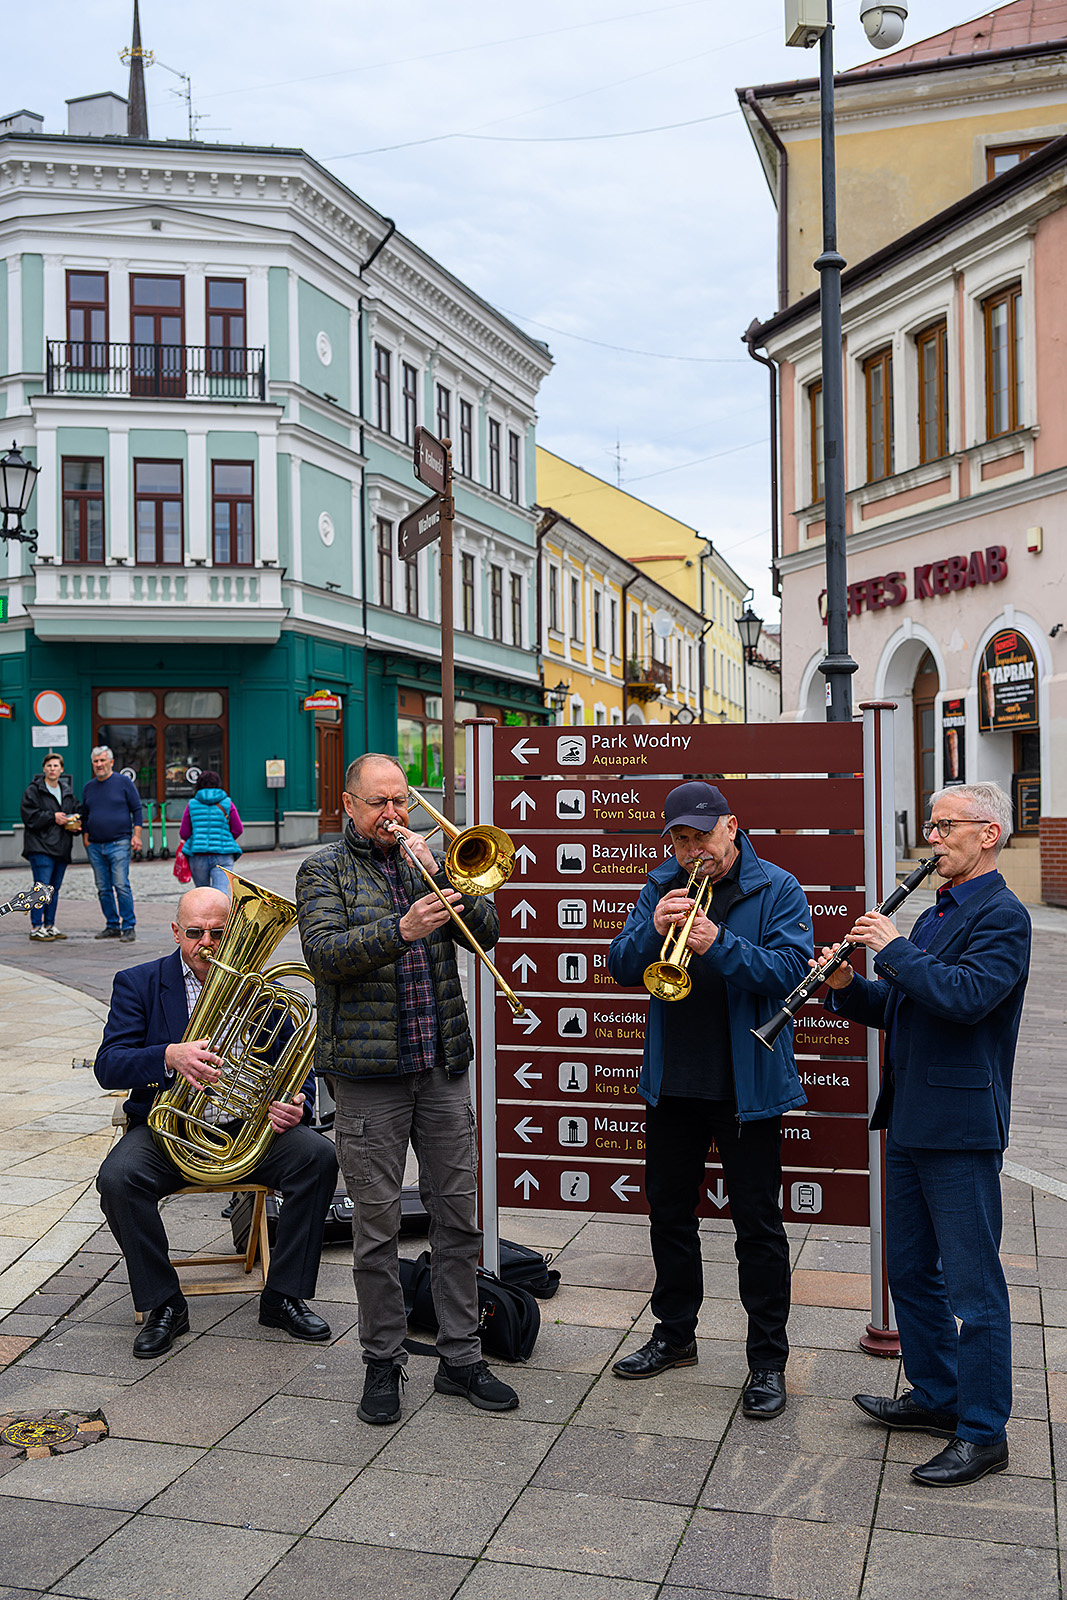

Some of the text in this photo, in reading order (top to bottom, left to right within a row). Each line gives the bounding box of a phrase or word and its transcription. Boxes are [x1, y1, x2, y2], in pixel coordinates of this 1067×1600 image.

[914, 545, 1008, 600] KEBAB
[988, 661, 1035, 685] YAPRAK
[591, 732, 692, 750] Park Wodny
[592, 754, 648, 766] Aquapark
[591, 788, 640, 805] Rynek
[593, 808, 624, 819] Town
[592, 843, 658, 861] Bazylika
[592, 863, 648, 874] Cathedral
[593, 918, 626, 929] Muse
[593, 1012, 646, 1024] Kościółki
[594, 1027, 614, 1039] (Na
[795, 1033, 850, 1045] Churches
[595, 1083, 620, 1096] King
[780, 1127, 811, 1140] ma
[595, 1137, 621, 1149] Gen.
[624, 1139, 633, 1151] J.
